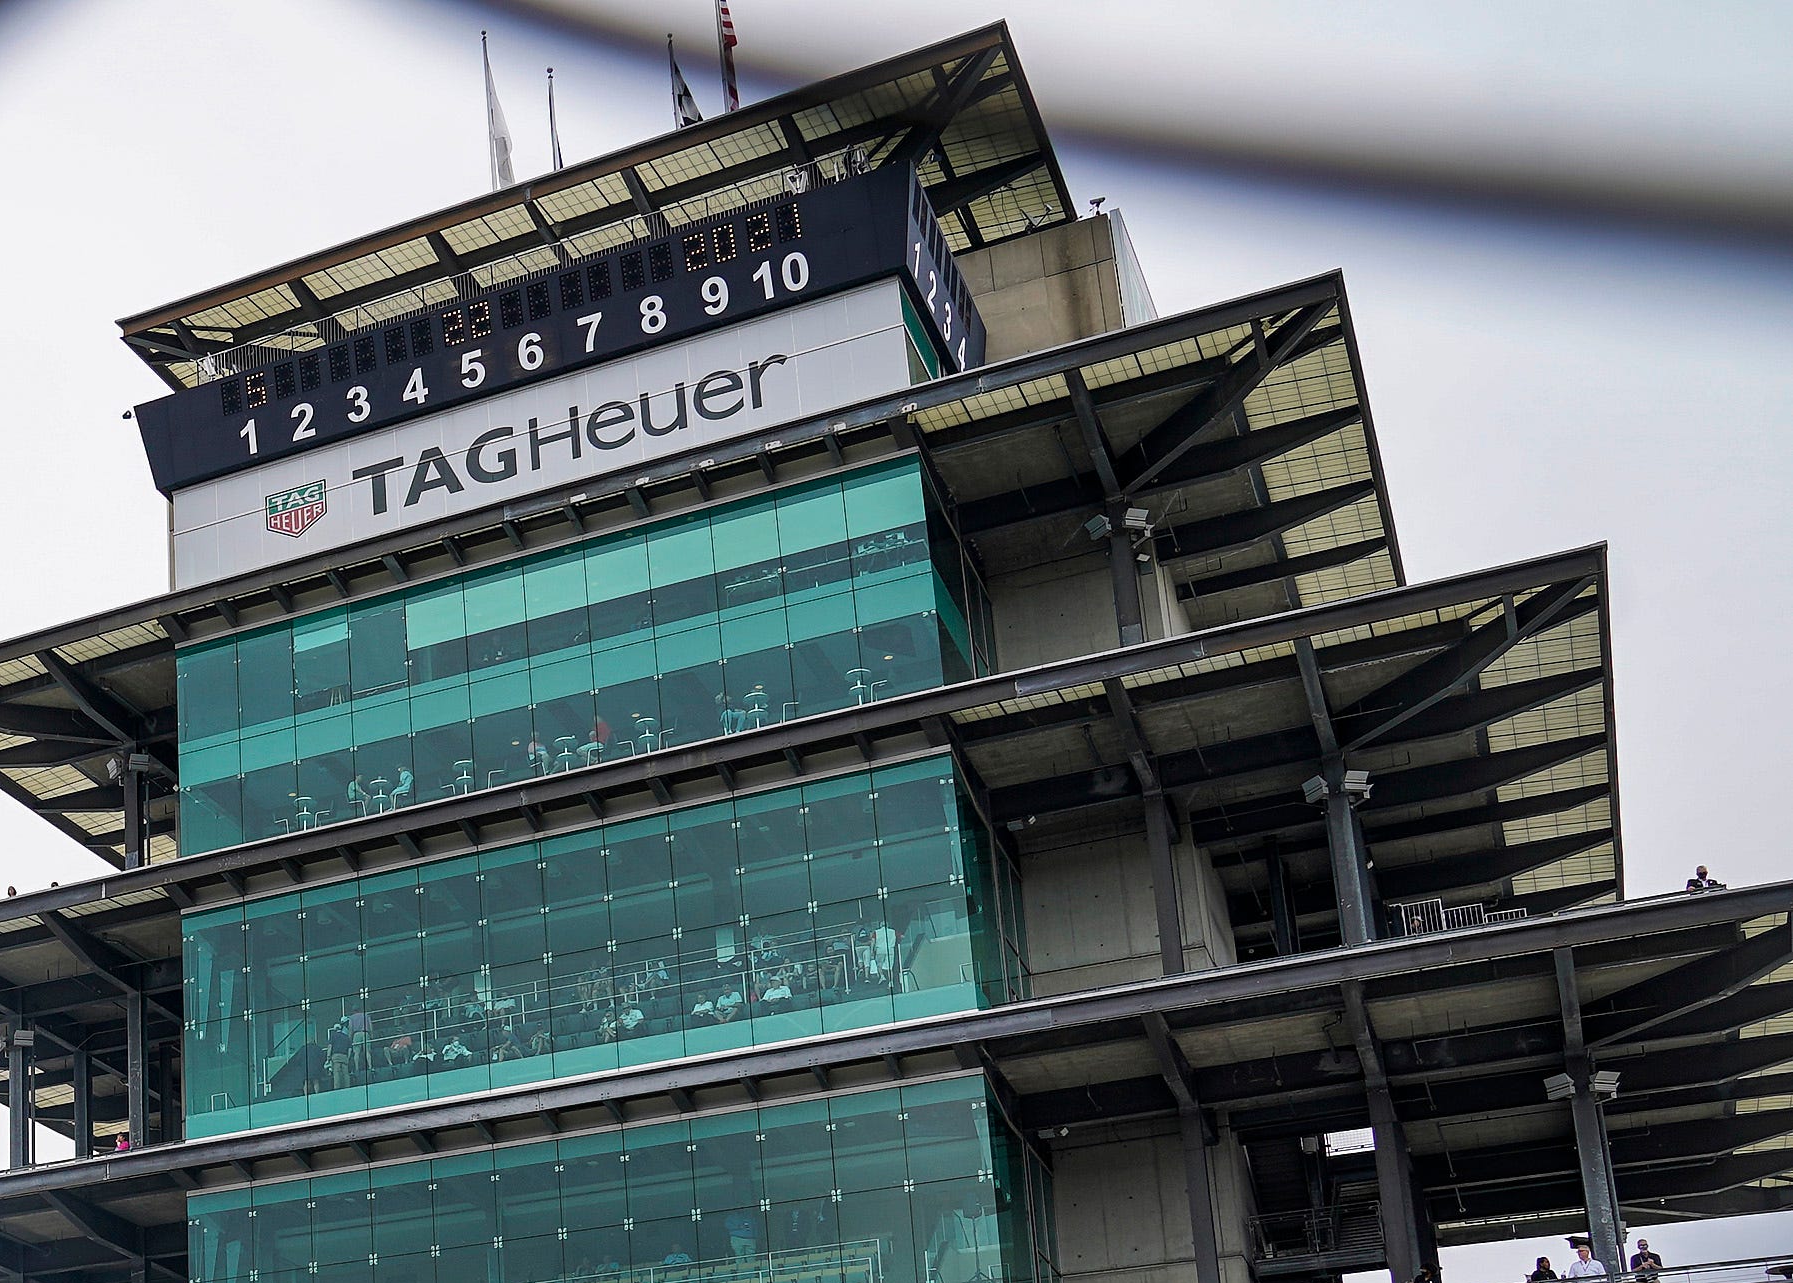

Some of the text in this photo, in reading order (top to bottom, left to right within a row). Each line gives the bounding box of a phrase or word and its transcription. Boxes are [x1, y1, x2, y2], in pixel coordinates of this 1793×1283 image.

[239, 251, 809, 455] 1 2 3 4 5 6 7 8 9 10
[914, 242, 966, 373] 1 2 3 4
[245, 372, 267, 408] 5
[442, 309, 492, 345] 22
[270, 503, 324, 533] HEUER
[271, 486, 319, 512] TAG
